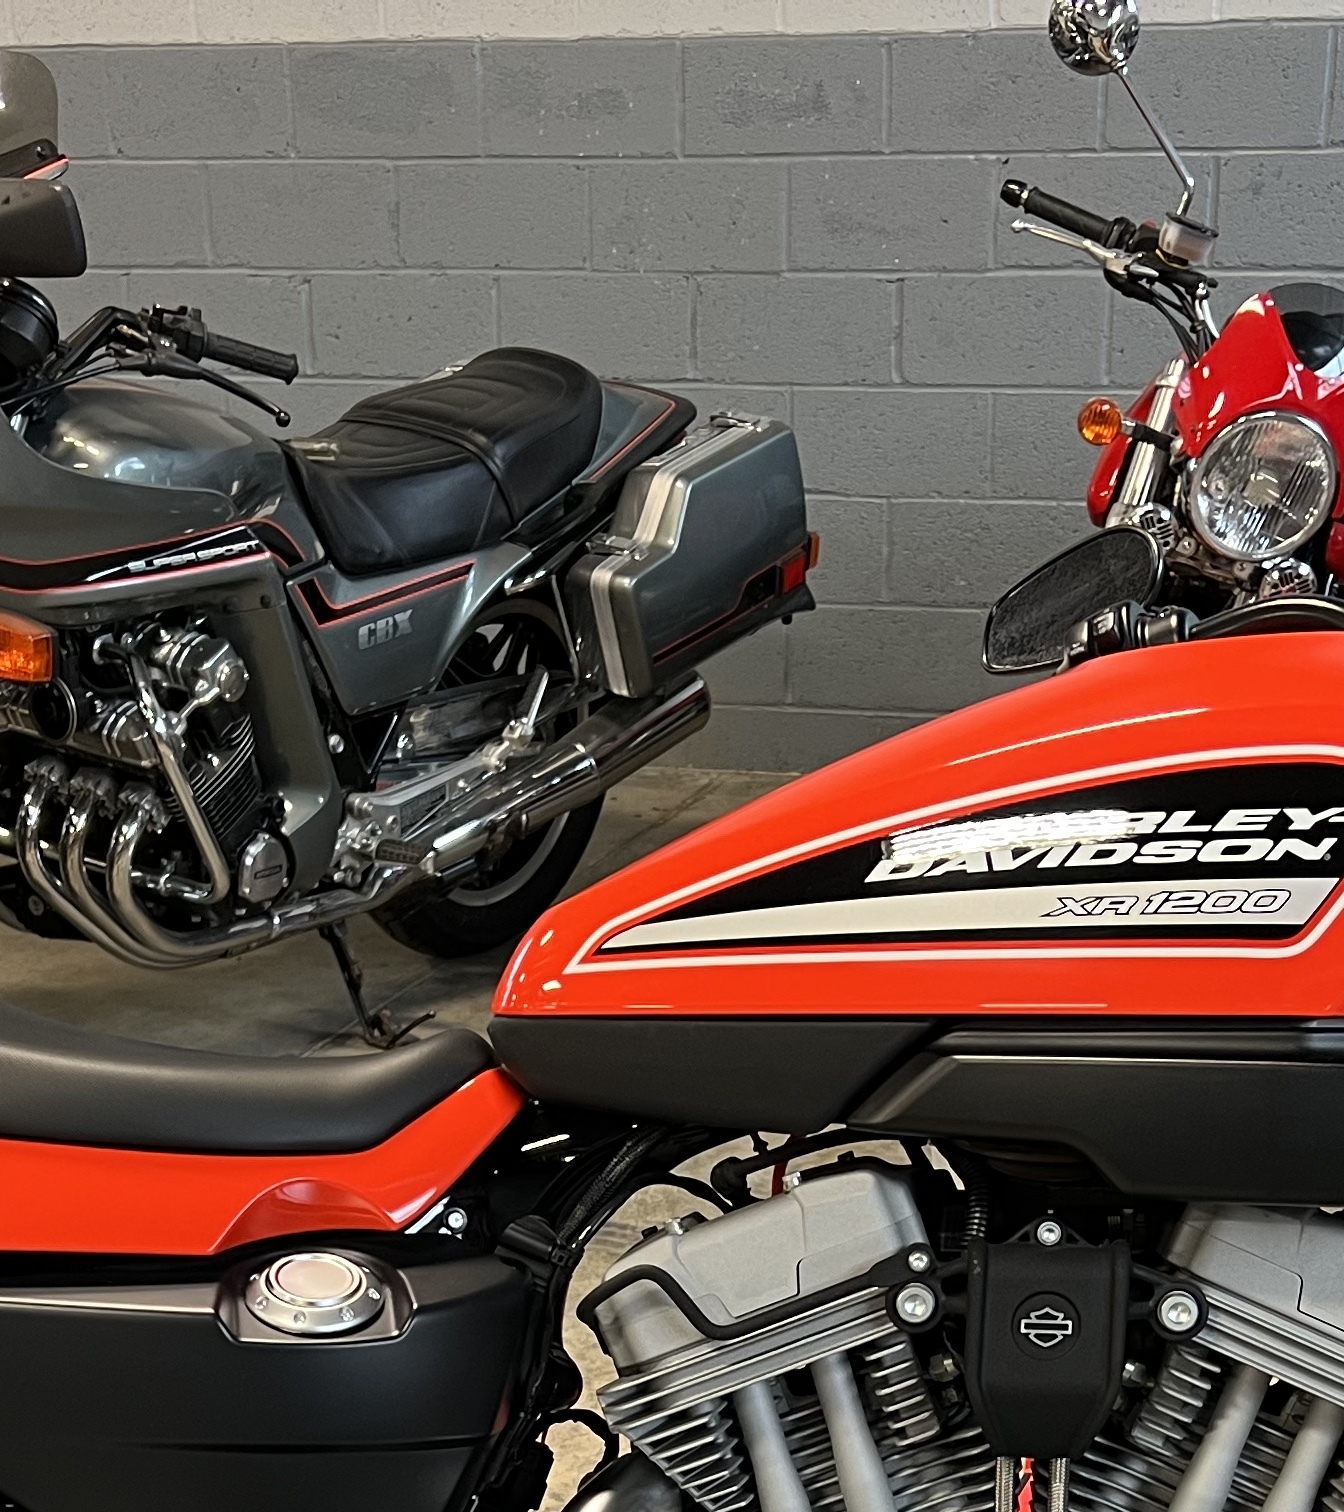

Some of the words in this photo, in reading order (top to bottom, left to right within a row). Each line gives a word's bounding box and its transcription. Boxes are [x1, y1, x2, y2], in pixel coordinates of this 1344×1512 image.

[127, 552, 196, 573] SUPER
[196, 540, 260, 561] SPORT
[358, 608, 414, 651] CBX
[864, 837, 1339, 883] DAVIDSON
